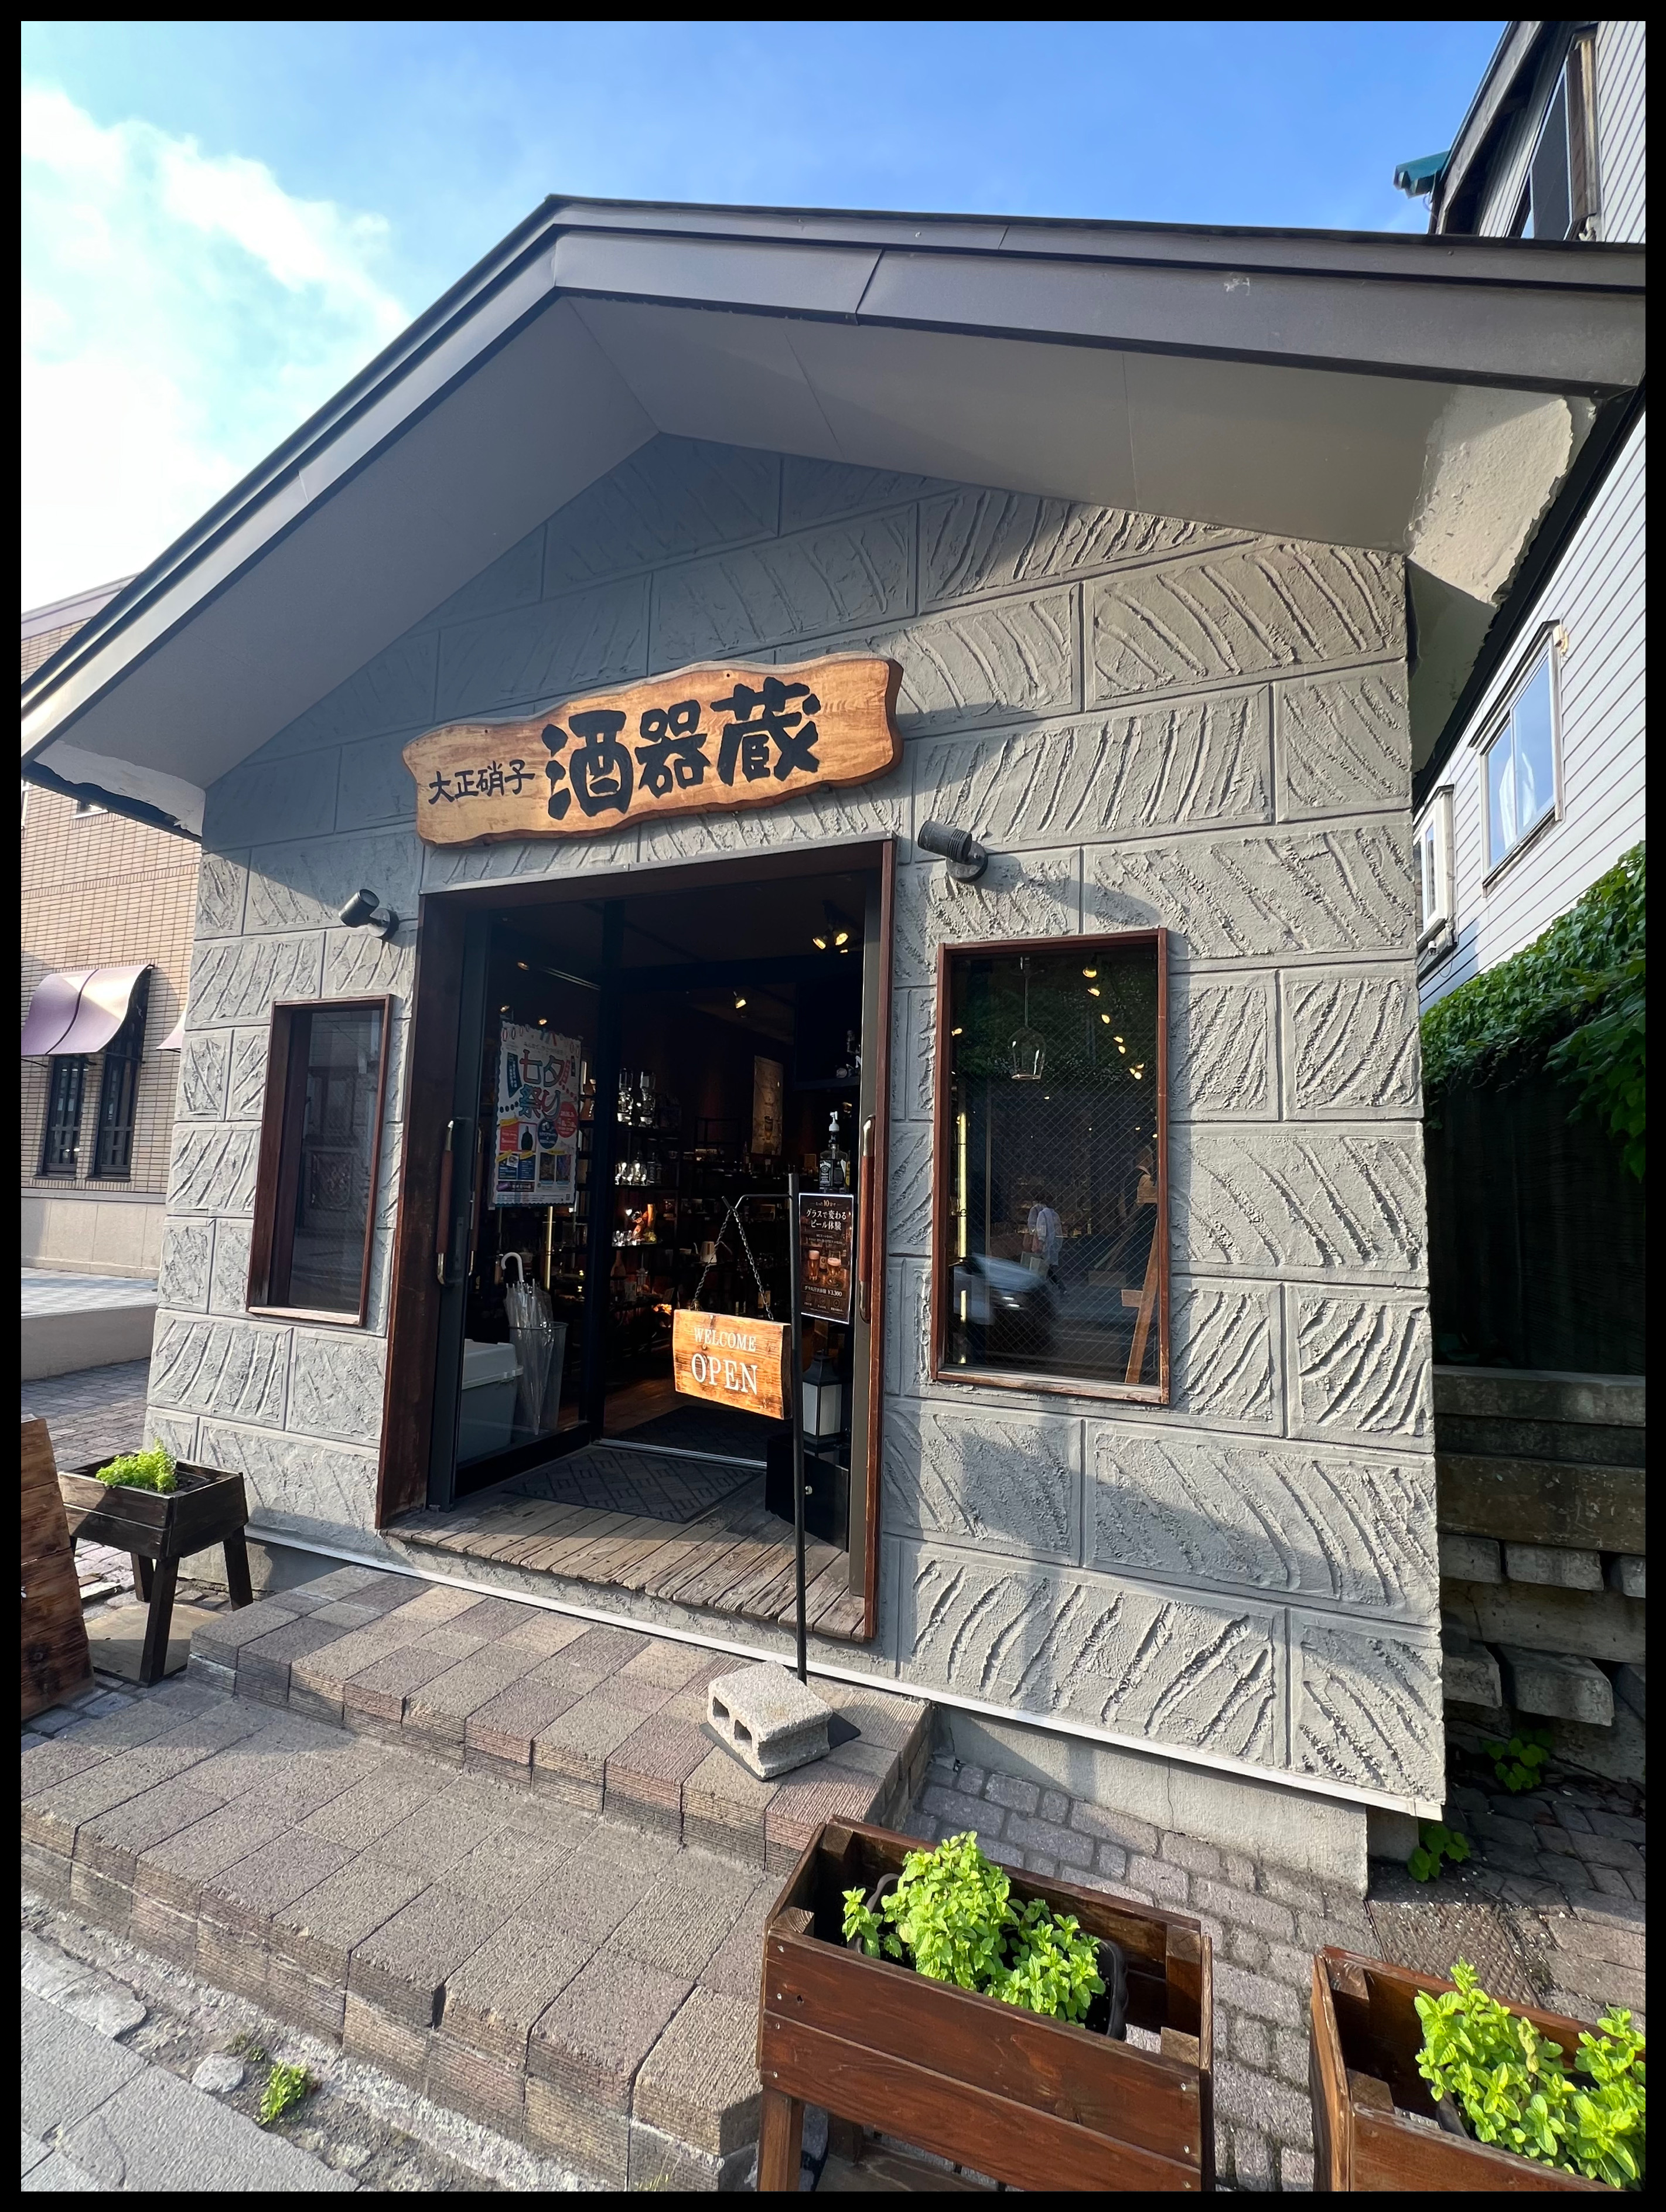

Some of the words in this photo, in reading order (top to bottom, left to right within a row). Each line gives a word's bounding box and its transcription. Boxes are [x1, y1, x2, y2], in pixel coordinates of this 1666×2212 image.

[427, 758, 535, 805] 大正硝子
[542, 676, 821, 820] 酒器蔵
[519, 1048, 565, 1088] 七夕
[518, 1084, 561, 1121] 祭り
[806, 1208, 846, 1221] グラスで変わる
[811, 1219, 842, 1231] ビール体験
[694, 1327, 756, 1352] WELCOME
[691, 1352, 758, 1395] OPEN
